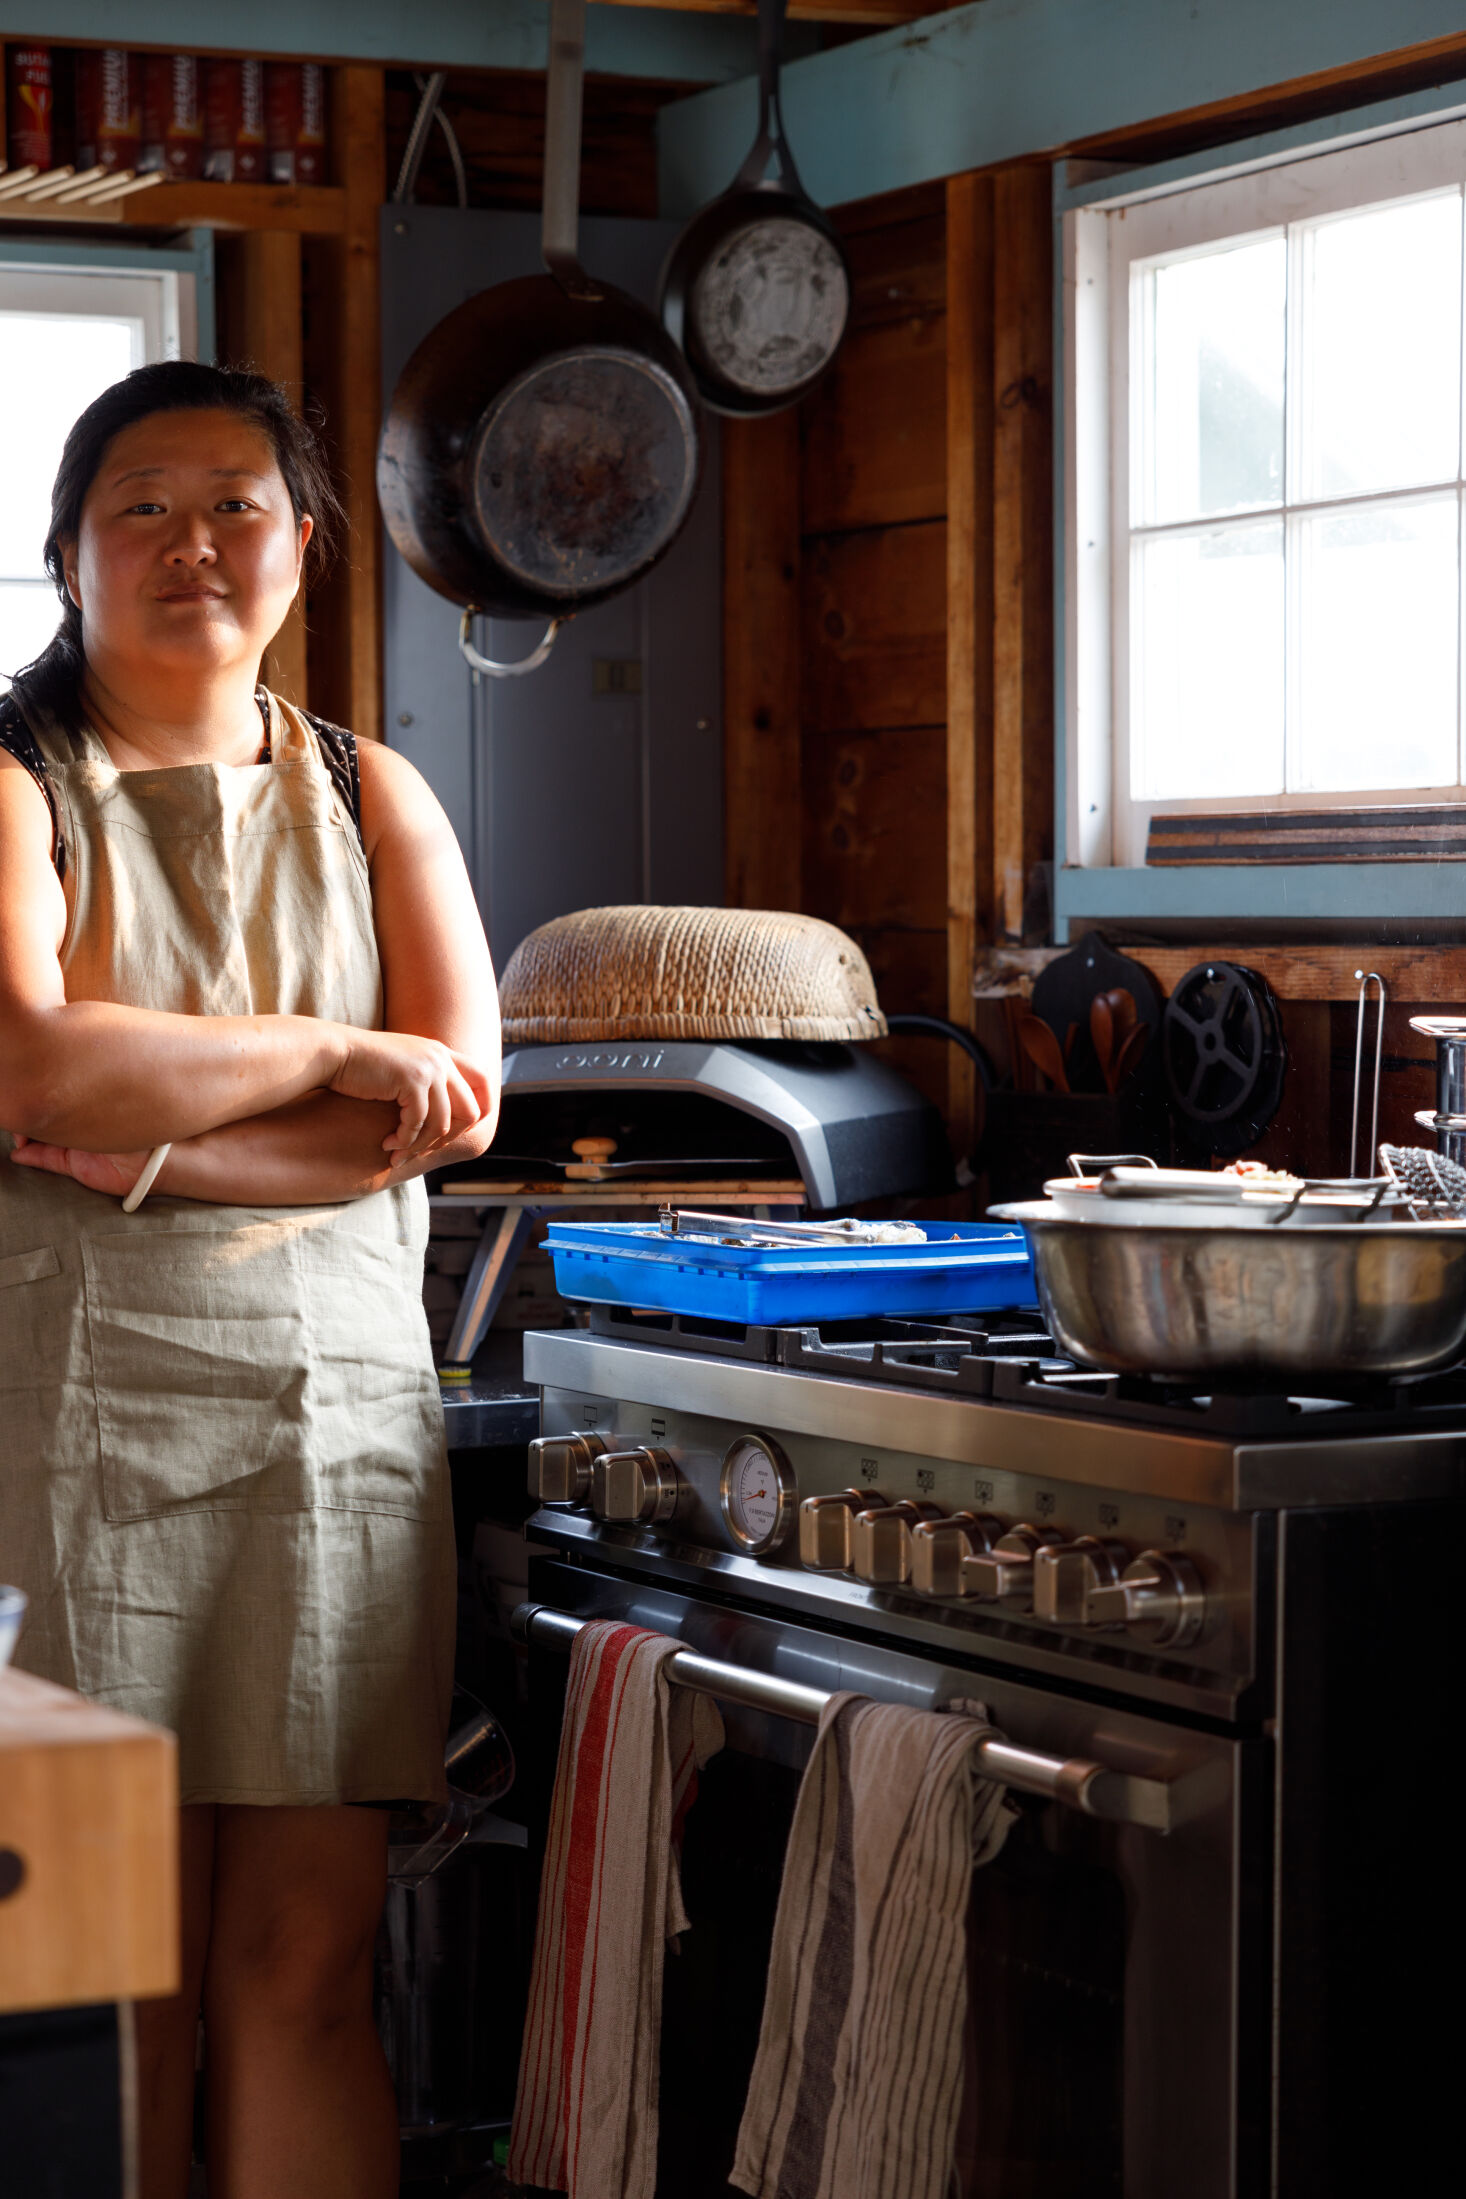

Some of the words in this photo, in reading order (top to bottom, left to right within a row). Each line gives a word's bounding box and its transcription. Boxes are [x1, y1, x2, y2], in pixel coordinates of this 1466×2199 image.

[103, 50, 121, 129] PREMIU
[173, 55, 191, 129] PREMIU
[242, 60, 258, 135] PREMIU
[302, 64, 318, 136] PREMIU
[556, 1049, 665, 1069] ooni
